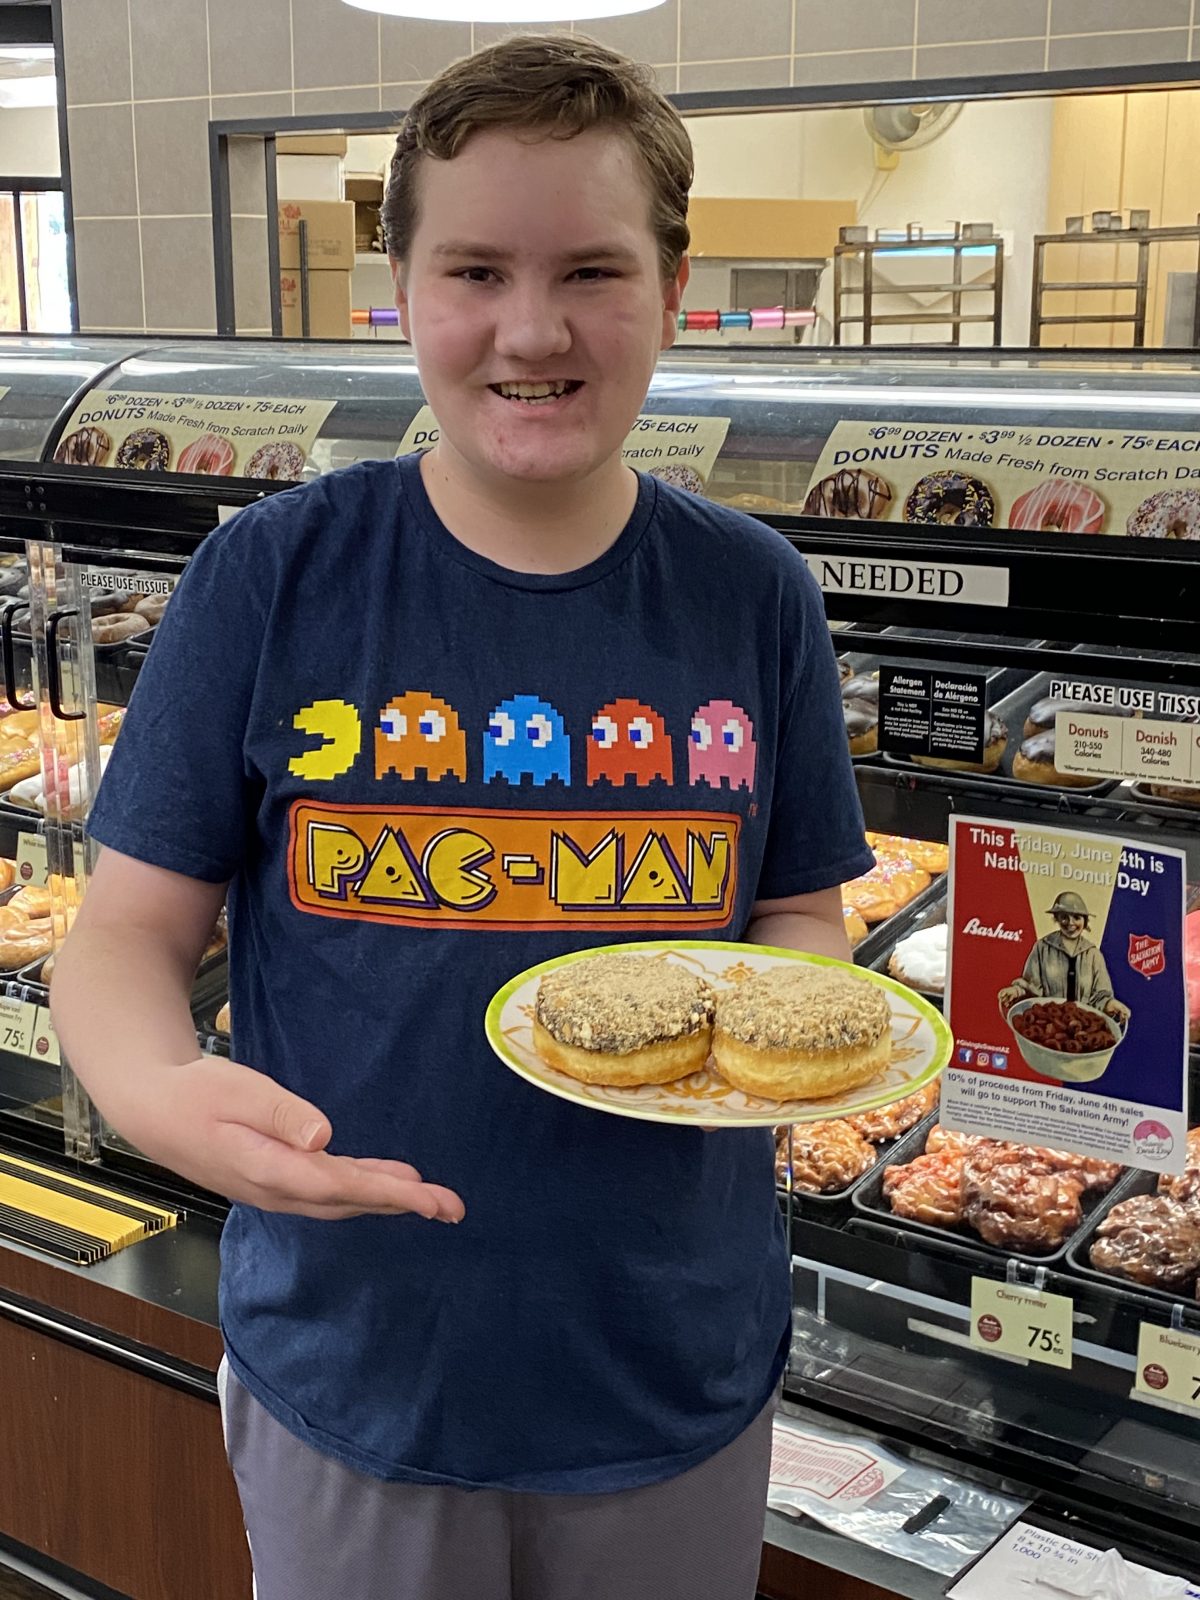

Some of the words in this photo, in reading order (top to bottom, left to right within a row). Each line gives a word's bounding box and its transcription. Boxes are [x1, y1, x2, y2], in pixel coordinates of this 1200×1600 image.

[125, 397, 163, 407] DOZEN
[205, 401, 244, 411] DOZEN
[272, 404, 306, 414] EACH
[79, 407, 145, 424] DONUTS
[147, 410, 176, 423] Made
[177, 415, 205, 429] Fresh
[206, 422, 229, 435] from
[231, 425, 275, 436] Scratch
[278, 423, 308, 435] Daily
[657, 422, 698, 433] EACH
[903, 430, 963, 442] DOZEN
[1037, 434, 1102, 448] DOZEN
[622, 447, 662, 458] ratch
[667, 444, 705, 457] Daily
[834, 444, 939, 465] DONUTS
[945, 448, 993, 464] Made
[997, 453, 1045, 472] Fresh
[1050, 462, 1089, 480] from
[1094, 467, 1169, 481] Scratch
[80, 573, 114, 589] PLEASE
[116, 576, 134, 591] USE
[136, 579, 169, 595] TISSUE
[821, 560, 964, 597] NEEDED
[893, 676, 923, 687] Allergen
[889, 685, 926, 697] Statement
[933, 690, 944, 699] de
[1050, 681, 1114, 706] PLEASE
[1119, 688, 1154, 711] USE
[1159, 693, 1200, 717] TISS
[1068, 723, 1109, 739] Donuts
[1135, 730, 1177, 746] Danish
[1074, 749, 1102, 759] Calories
[1141, 756, 1170, 766] Calories
[970, 828, 1005, 847] This
[1010, 834, 1067, 860] Friday,
[1071, 843, 1113, 863] June
[1119, 850, 1145, 870] 4th
[1150, 856, 1165, 874] is
[307, 821, 729, 912] PAC-MAN
[984, 851, 1055, 878] National
[1060, 863, 1113, 887] Donut
[1117, 872, 1150, 897] Day
[948, 1072, 965, 1083] 10%
[968, 1077, 977, 1085] of
[979, 1079, 1020, 1093] proceeds
[1022, 1086, 1044, 1097] from
[1045, 1090, 1076, 1105] Friday,
[1078, 1096, 1100, 1108] June
[1102, 1102, 1118, 1112] 4th
[1120, 1105, 1144, 1118] sales
[960, 1087, 976, 1097] will
[977, 1090, 989, 1100] go
[991, 1092, 1001, 1101] to
[1003, 1095, 1037, 1108] support
[1039, 1100, 1057, 1111] The
[1059, 1104, 1101, 1121] Salvation
[1103, 1113, 1129, 1127] Army!
[996, 1289, 1022, 1304] Cherry
[1024, 1528, 1060, 1547] Plastic
[1060, 1543, 1084, 1556] Deli
[1067, 1556, 1079, 1566] in
